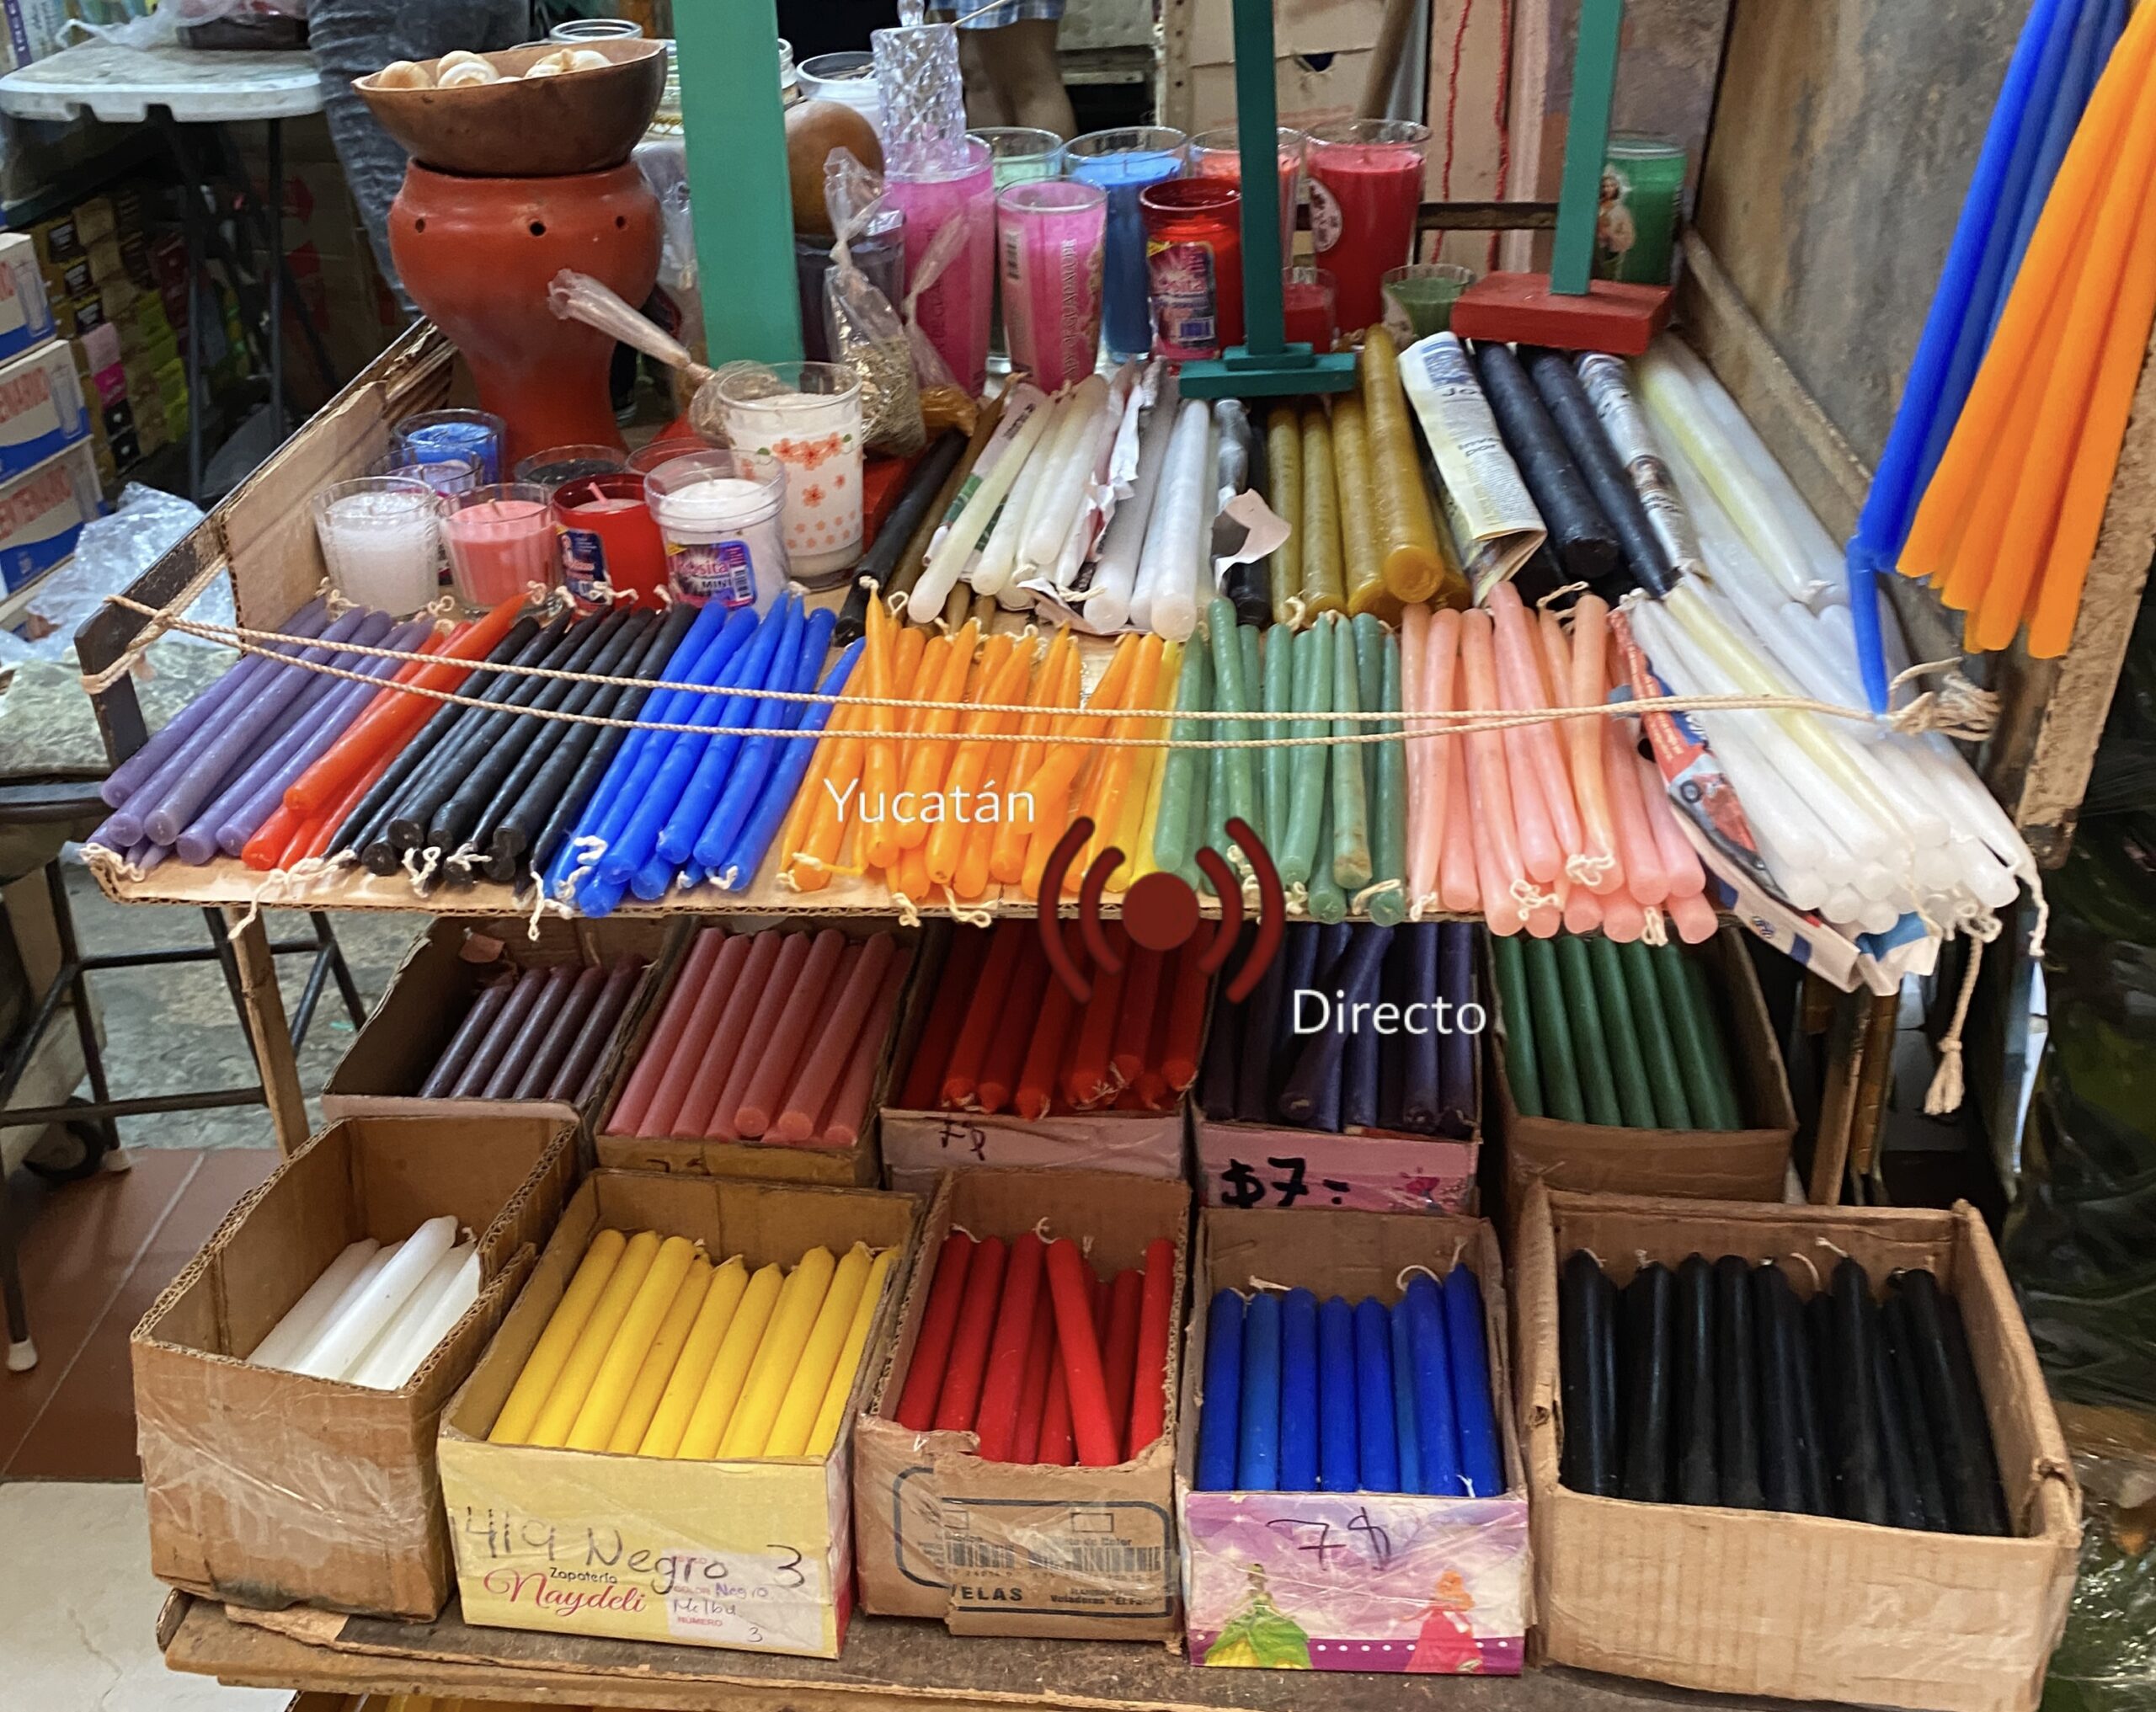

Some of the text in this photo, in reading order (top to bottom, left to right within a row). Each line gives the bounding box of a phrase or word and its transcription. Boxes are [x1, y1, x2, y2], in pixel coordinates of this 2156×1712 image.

[585, 1527, 728, 1595] Negro
[766, 1544, 805, 1589] 3
[483, 1568, 647, 1617] Naydeli
[715, 1582, 770, 1599] Negro
[747, 1626, 764, 1643] 3
